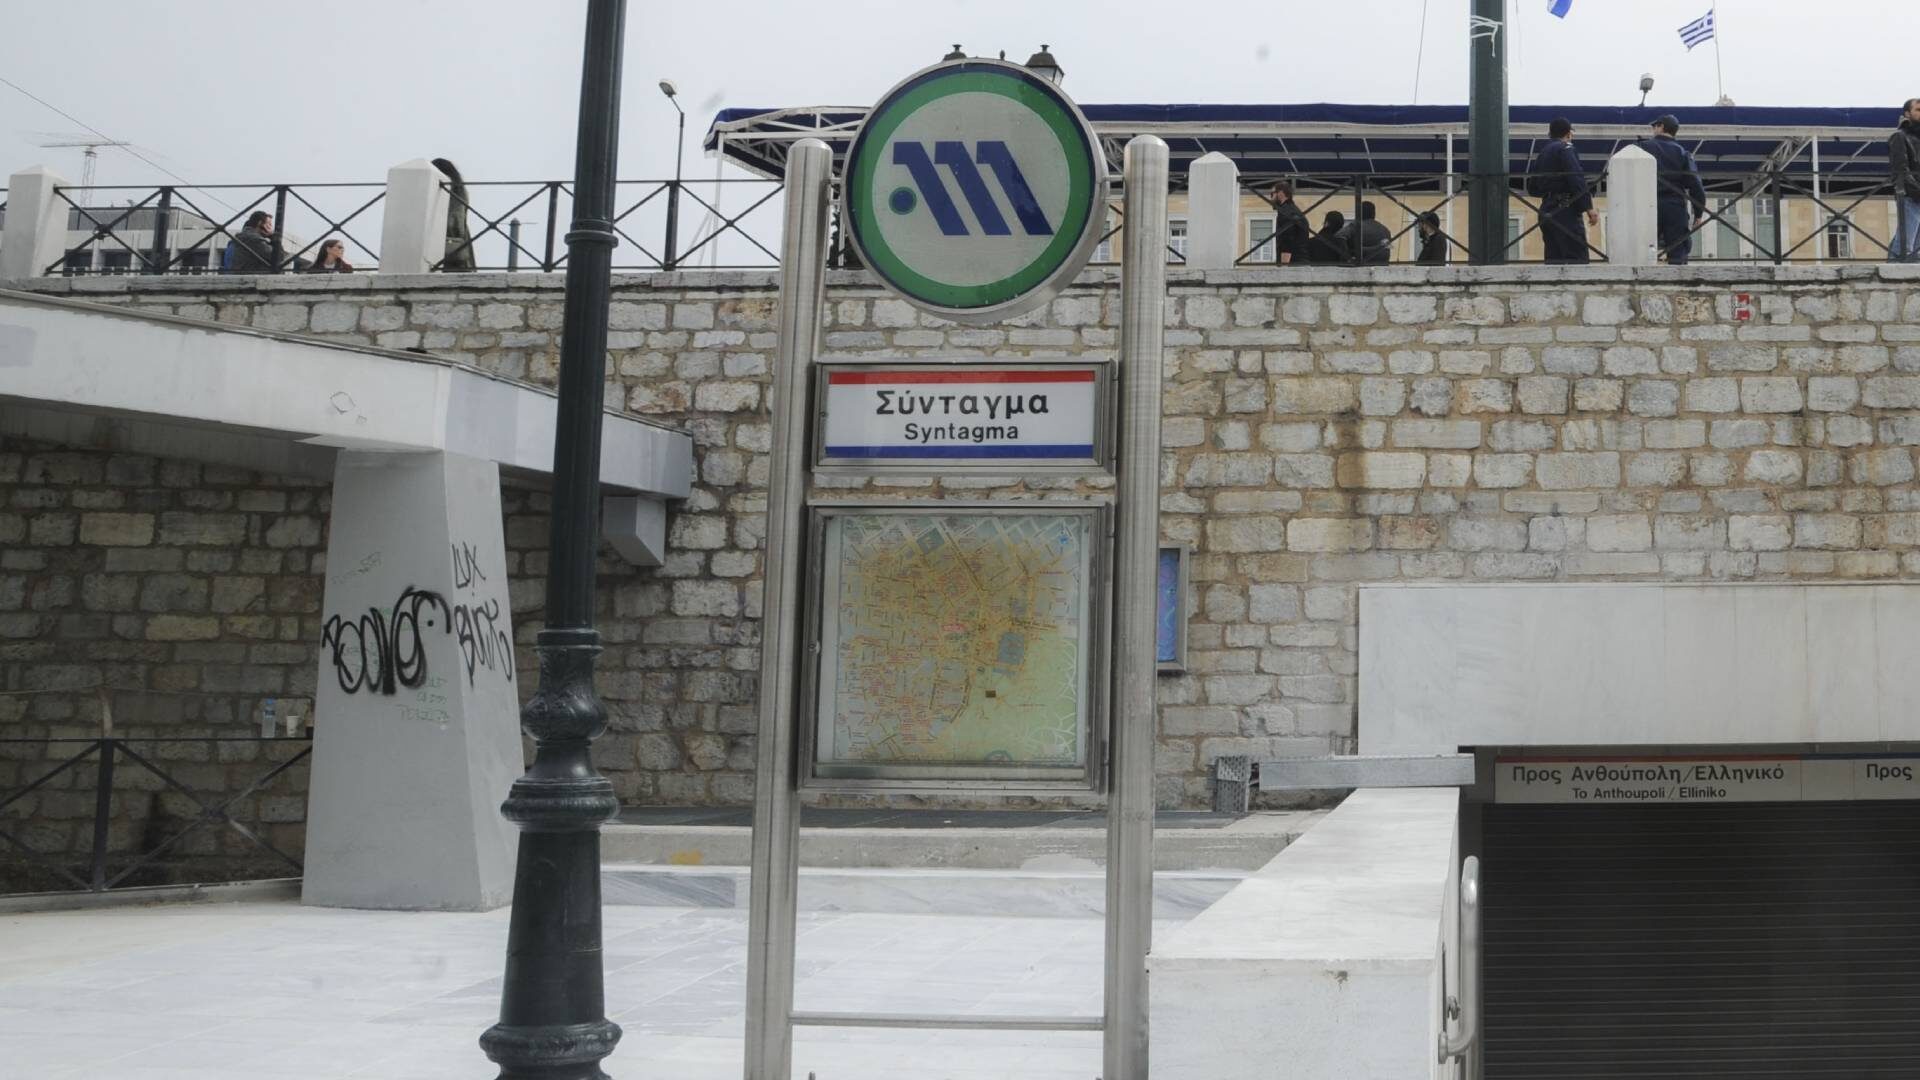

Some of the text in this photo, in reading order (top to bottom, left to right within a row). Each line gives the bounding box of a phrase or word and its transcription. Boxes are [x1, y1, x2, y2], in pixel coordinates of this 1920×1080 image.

[875, 389, 1049, 419] Σύνταγμα
[904, 423, 1019, 443] Syntagma
[1512, 765, 1562, 784] Προς
[1865, 763, 1913, 781] Προς
[1573, 787, 1588, 799] To
